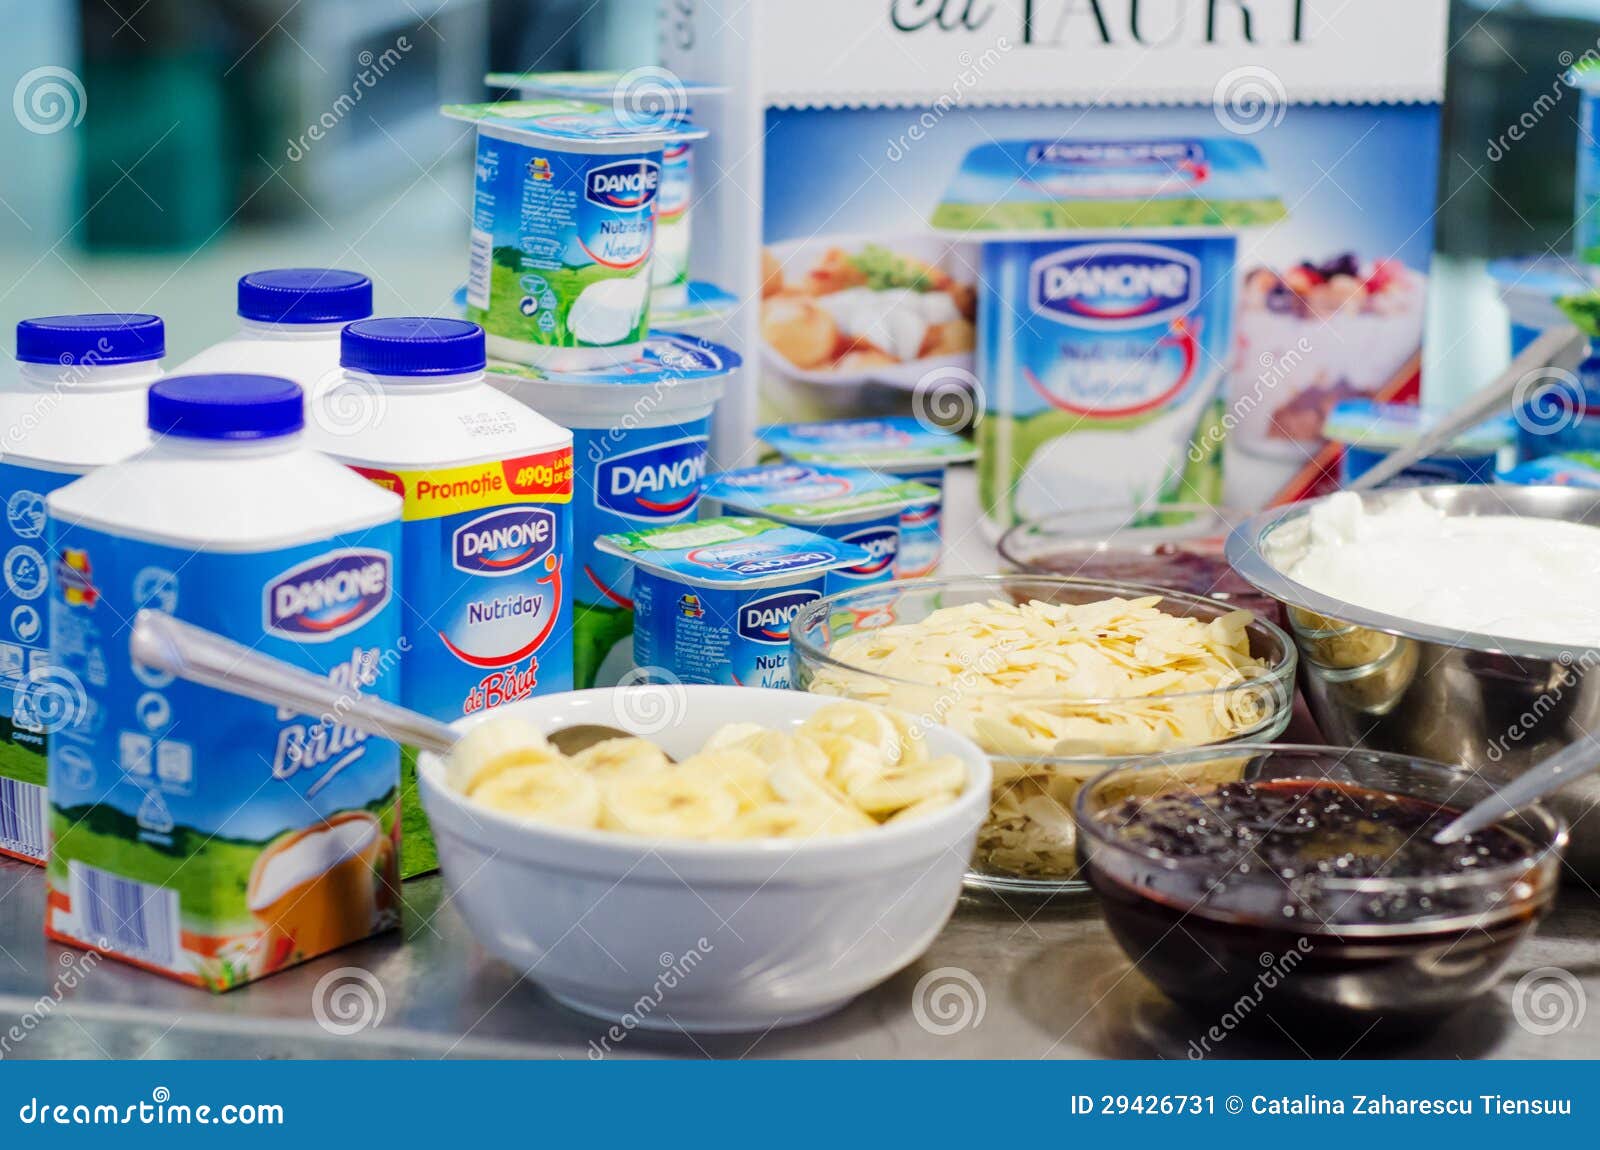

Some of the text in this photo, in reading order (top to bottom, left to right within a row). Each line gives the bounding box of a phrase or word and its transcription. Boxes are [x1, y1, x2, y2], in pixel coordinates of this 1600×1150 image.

[515, 465, 553, 488] 490g
[610, 453, 706, 495] DANON
[469, 596, 542, 624] Nutriday
[747, 602, 808, 628] DANO
[463, 656, 538, 714] de Băut
